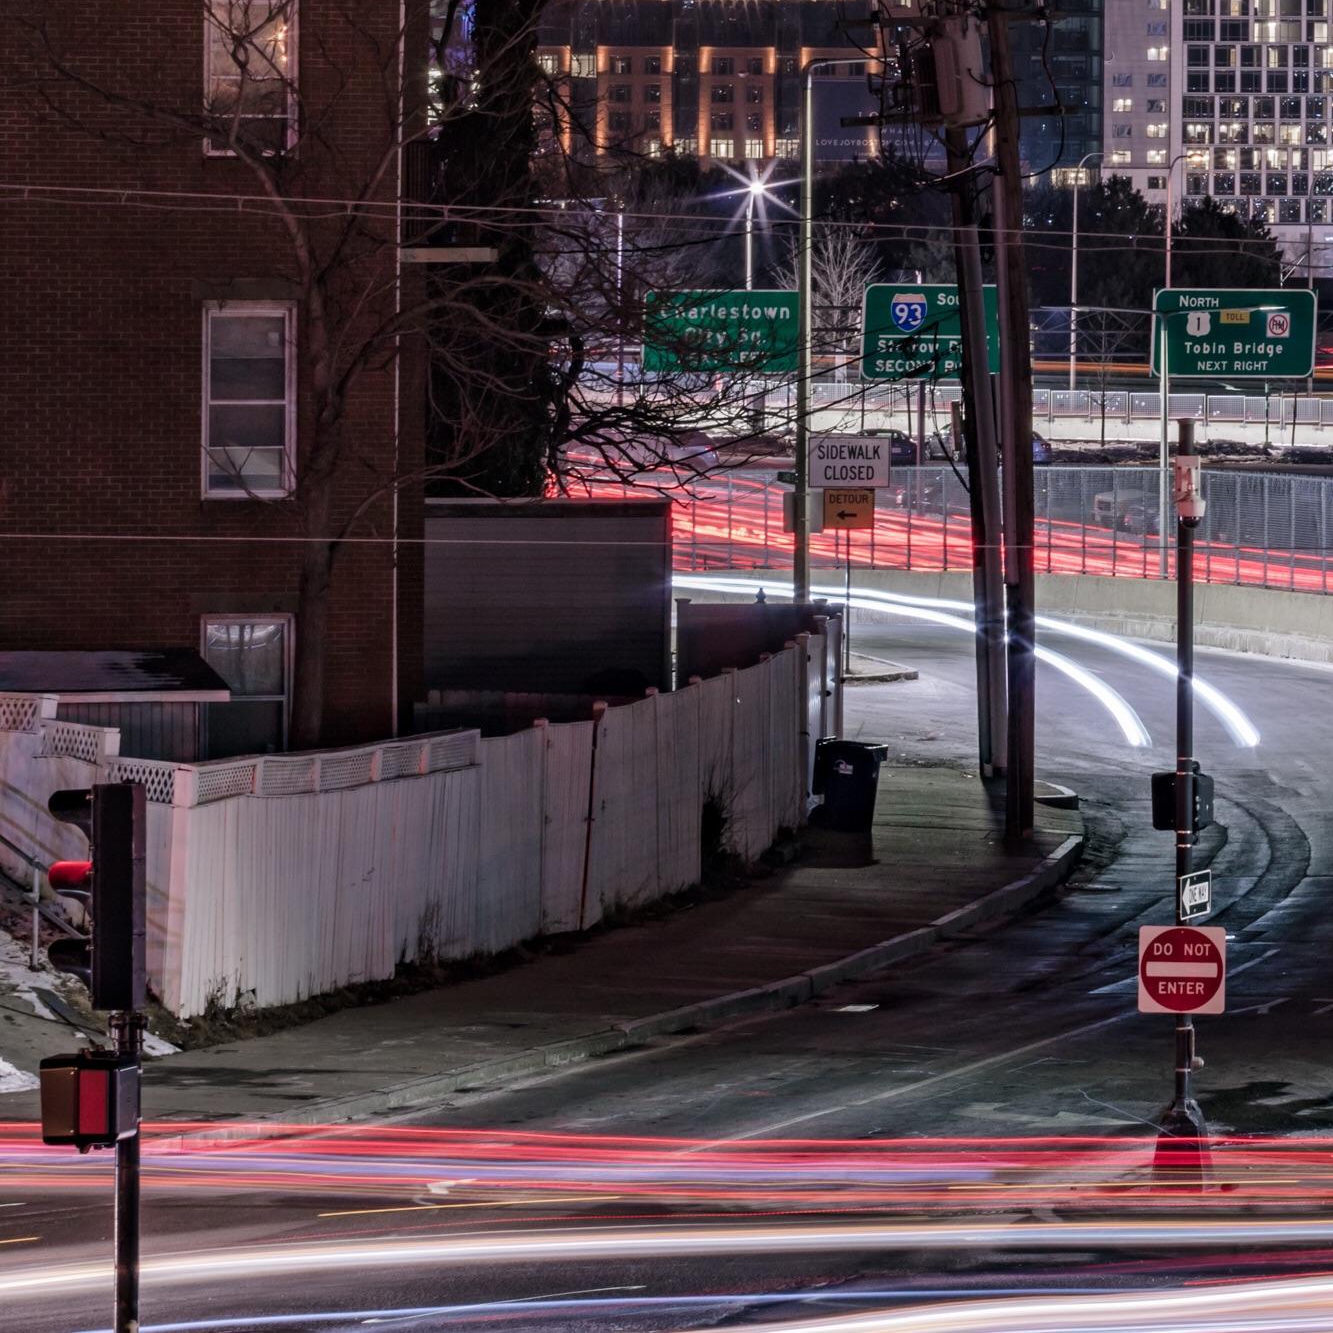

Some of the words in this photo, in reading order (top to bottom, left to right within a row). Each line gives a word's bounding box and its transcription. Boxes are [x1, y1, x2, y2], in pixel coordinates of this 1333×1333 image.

[1179, 295, 1219, 308] NORTH
[895, 303, 922, 326] 93
[1225, 313, 1245, 321] TOLL
[1184, 342, 1226, 354] Tobin
[1233, 342, 1283, 357] Bridge
[1197, 361, 1228, 371] NEXT
[1234, 361, 1269, 371] RIGHT
[817, 444, 881, 460] SIDEWALK
[824, 465, 875, 481] CLOSED
[829, 494, 869, 504] DETOUR
[1153, 942, 1173, 956] DO
[1183, 943, 1211, 956] NOT
[1158, 981, 1204, 995] ENTER
